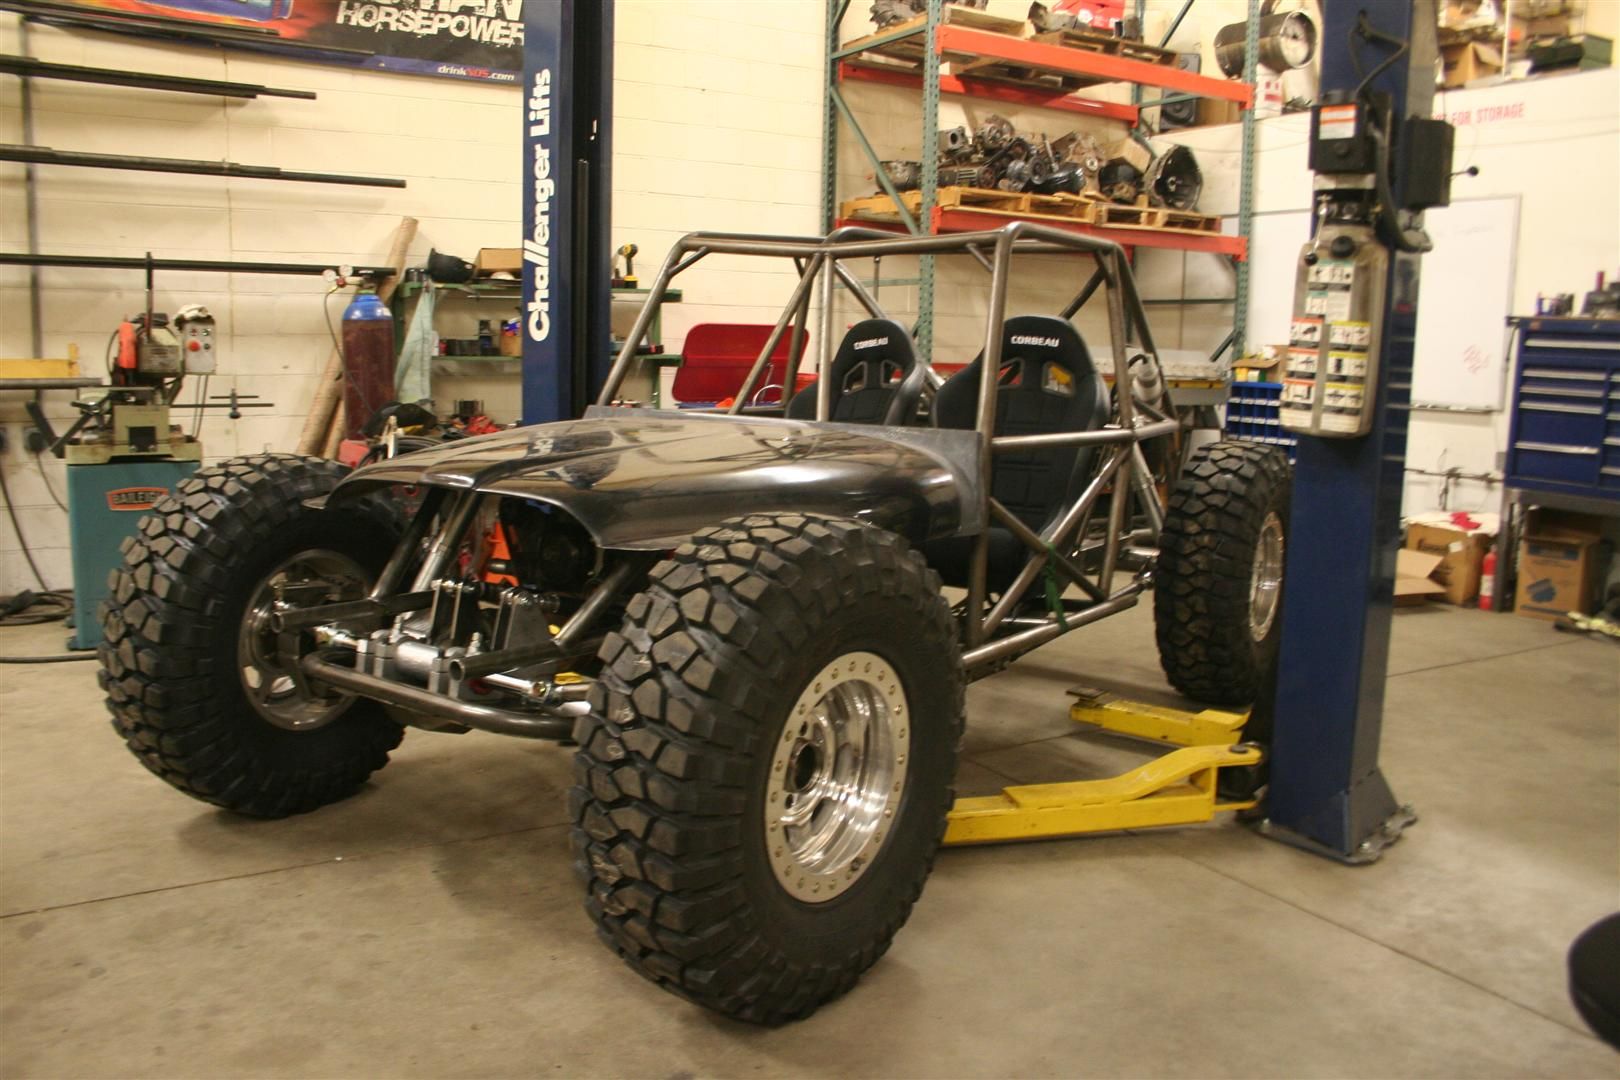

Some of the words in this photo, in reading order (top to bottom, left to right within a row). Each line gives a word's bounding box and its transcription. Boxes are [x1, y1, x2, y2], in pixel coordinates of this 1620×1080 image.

[335, 1, 525, 47] HORSEPOWER
[528, 68, 551, 137] Lifts
[1451, 111, 1472, 126] FOR
[1476, 103, 1525, 123] STORAGE
[523, 143, 554, 342] Challenger
[853, 336, 889, 350] CORBEAU
[1010, 334, 1060, 348] CORBEAU
